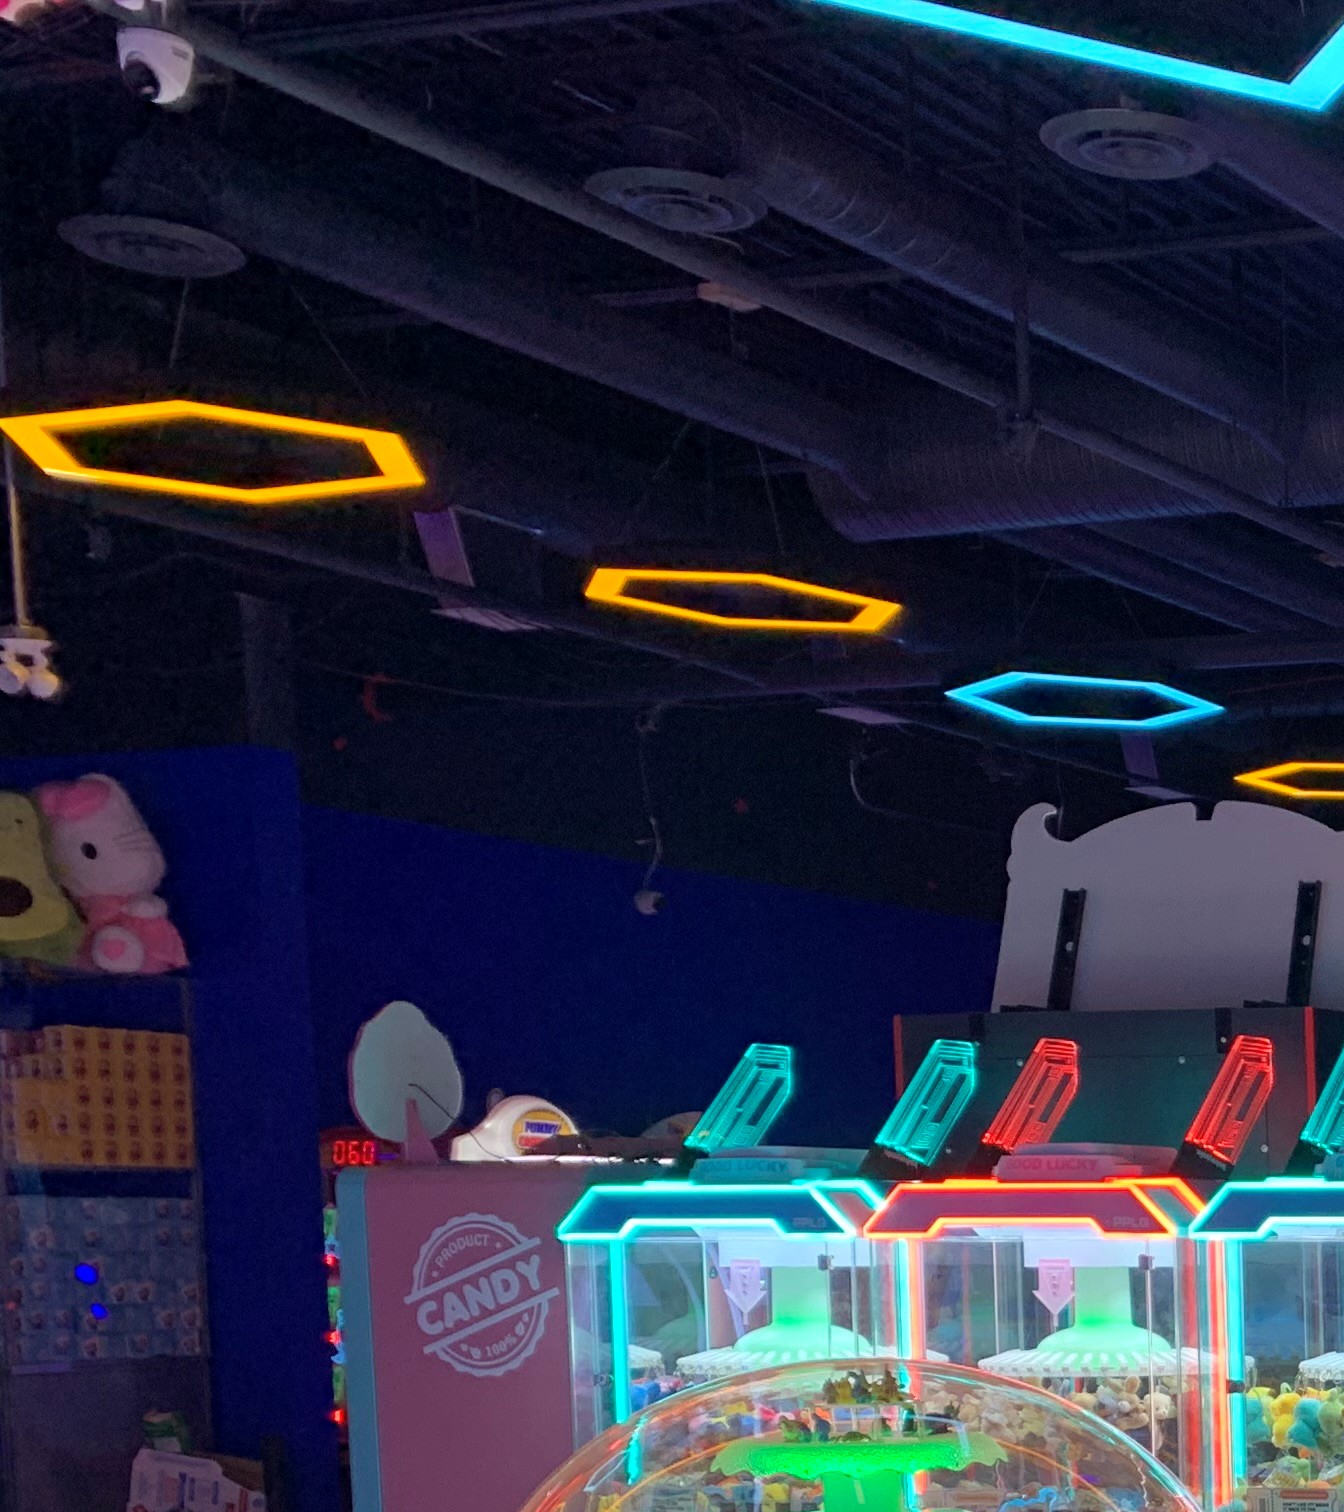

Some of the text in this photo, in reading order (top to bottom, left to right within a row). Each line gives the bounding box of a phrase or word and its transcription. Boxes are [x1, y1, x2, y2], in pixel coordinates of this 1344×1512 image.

[1046, 1157, 1098, 1172] LUCKY
[435, 1233, 490, 1269] PRODUCT
[415, 1254, 543, 1336] CANDY
[485, 1333, 517, 1359] 100%
